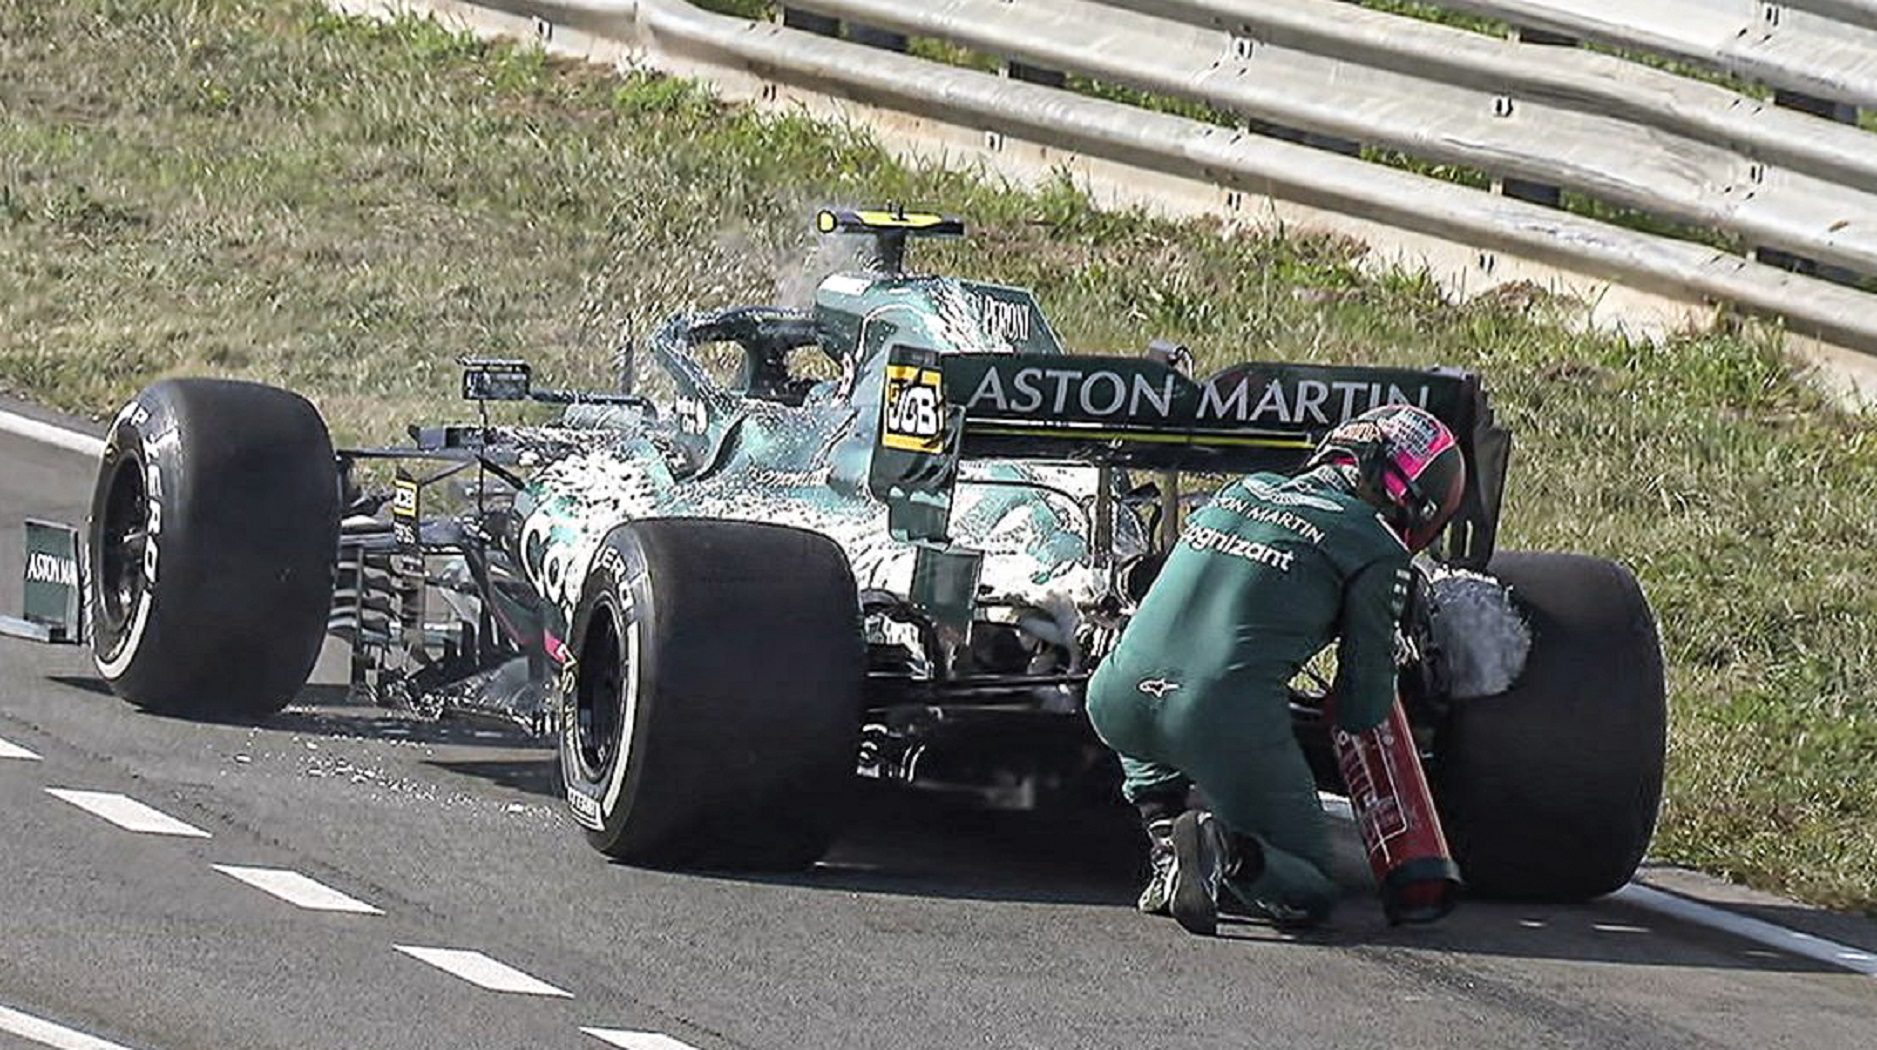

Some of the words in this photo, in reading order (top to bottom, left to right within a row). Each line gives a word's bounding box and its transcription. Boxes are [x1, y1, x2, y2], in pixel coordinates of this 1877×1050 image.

[888, 383, 938, 435] JCB
[967, 366, 1176, 417] ASTON
[1197, 377, 1429, 424] MARTIN
[1246, 507, 1326, 544] MARTIN
